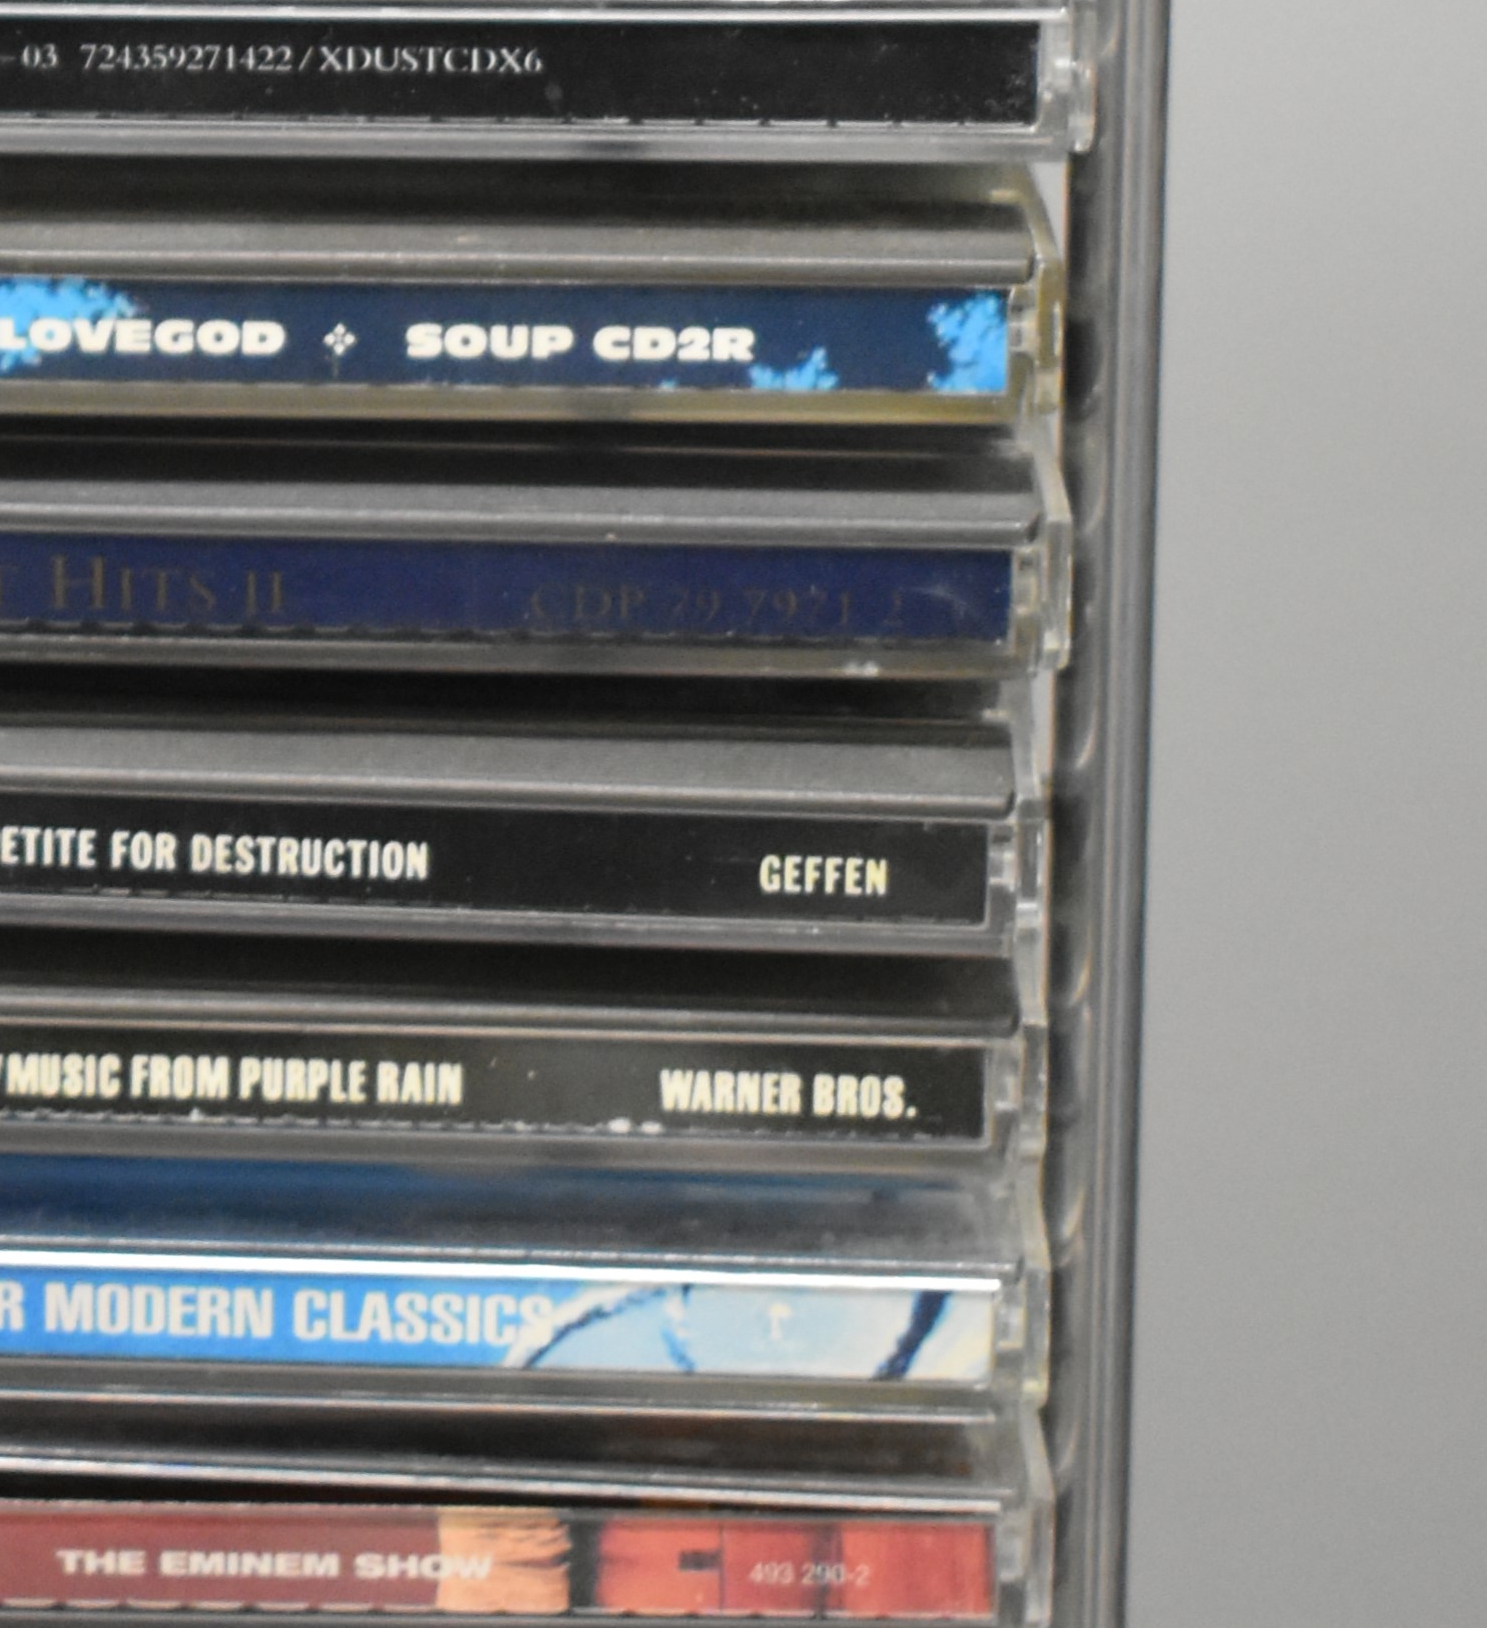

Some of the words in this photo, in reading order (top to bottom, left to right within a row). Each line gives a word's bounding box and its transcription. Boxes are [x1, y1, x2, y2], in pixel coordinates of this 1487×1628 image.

[21, 45, 59, 71] 03
[406, 324, 574, 360] SOUP
[592, 326, 755, 363] CD2R
[111, 831, 176, 870] FOR
[191, 834, 428, 881] DESTRUCTION
[759, 856, 888, 896] GEFFEN
[131, 1054, 227, 1099] FROM
[239, 1057, 365, 1103] PURPLE
[377, 1061, 460, 1104] RAIN
[660, 1069, 800, 1115] WARNER
[814, 1074, 916, 1118] BROS.
[46, 1282, 273, 1338] MODERN
[293, 1290, 552, 1347] CLASSICS
[56, 1548, 145, 1575] THE
[159, 1550, 342, 1579] EMINEM
[354, 1550, 494, 1580] SHOW
[749, 1560, 794, 1584] 493
[802, 1560, 869, 1586] 290-2
